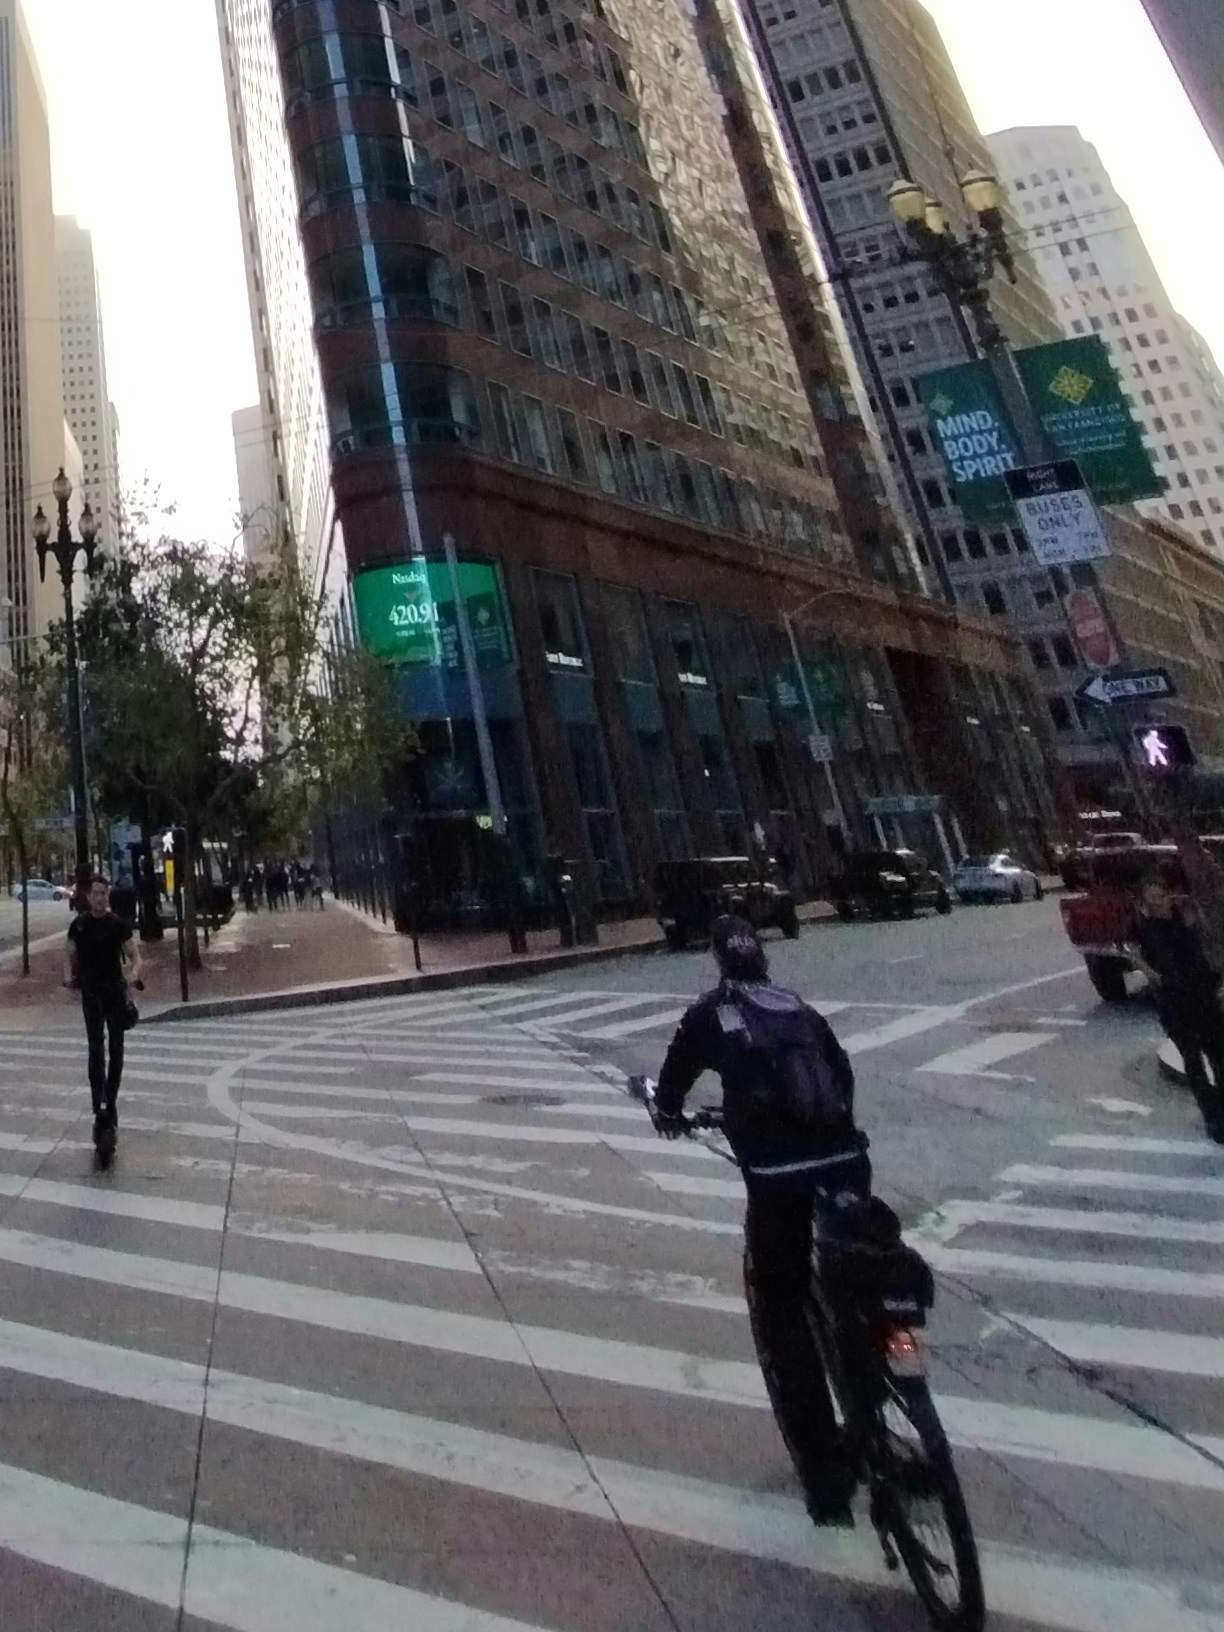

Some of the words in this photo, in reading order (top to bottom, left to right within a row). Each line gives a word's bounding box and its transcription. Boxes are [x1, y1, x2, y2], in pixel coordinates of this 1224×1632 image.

[936, 410, 1000, 438] MIND.
[942, 431, 1006, 461] BODY.
[1026, 495, 1083, 516] BUSES
[1037, 512, 1080, 530] ONLY
[392, 571, 426, 585] Nasdaq
[388, 601, 439, 626] 420.91
